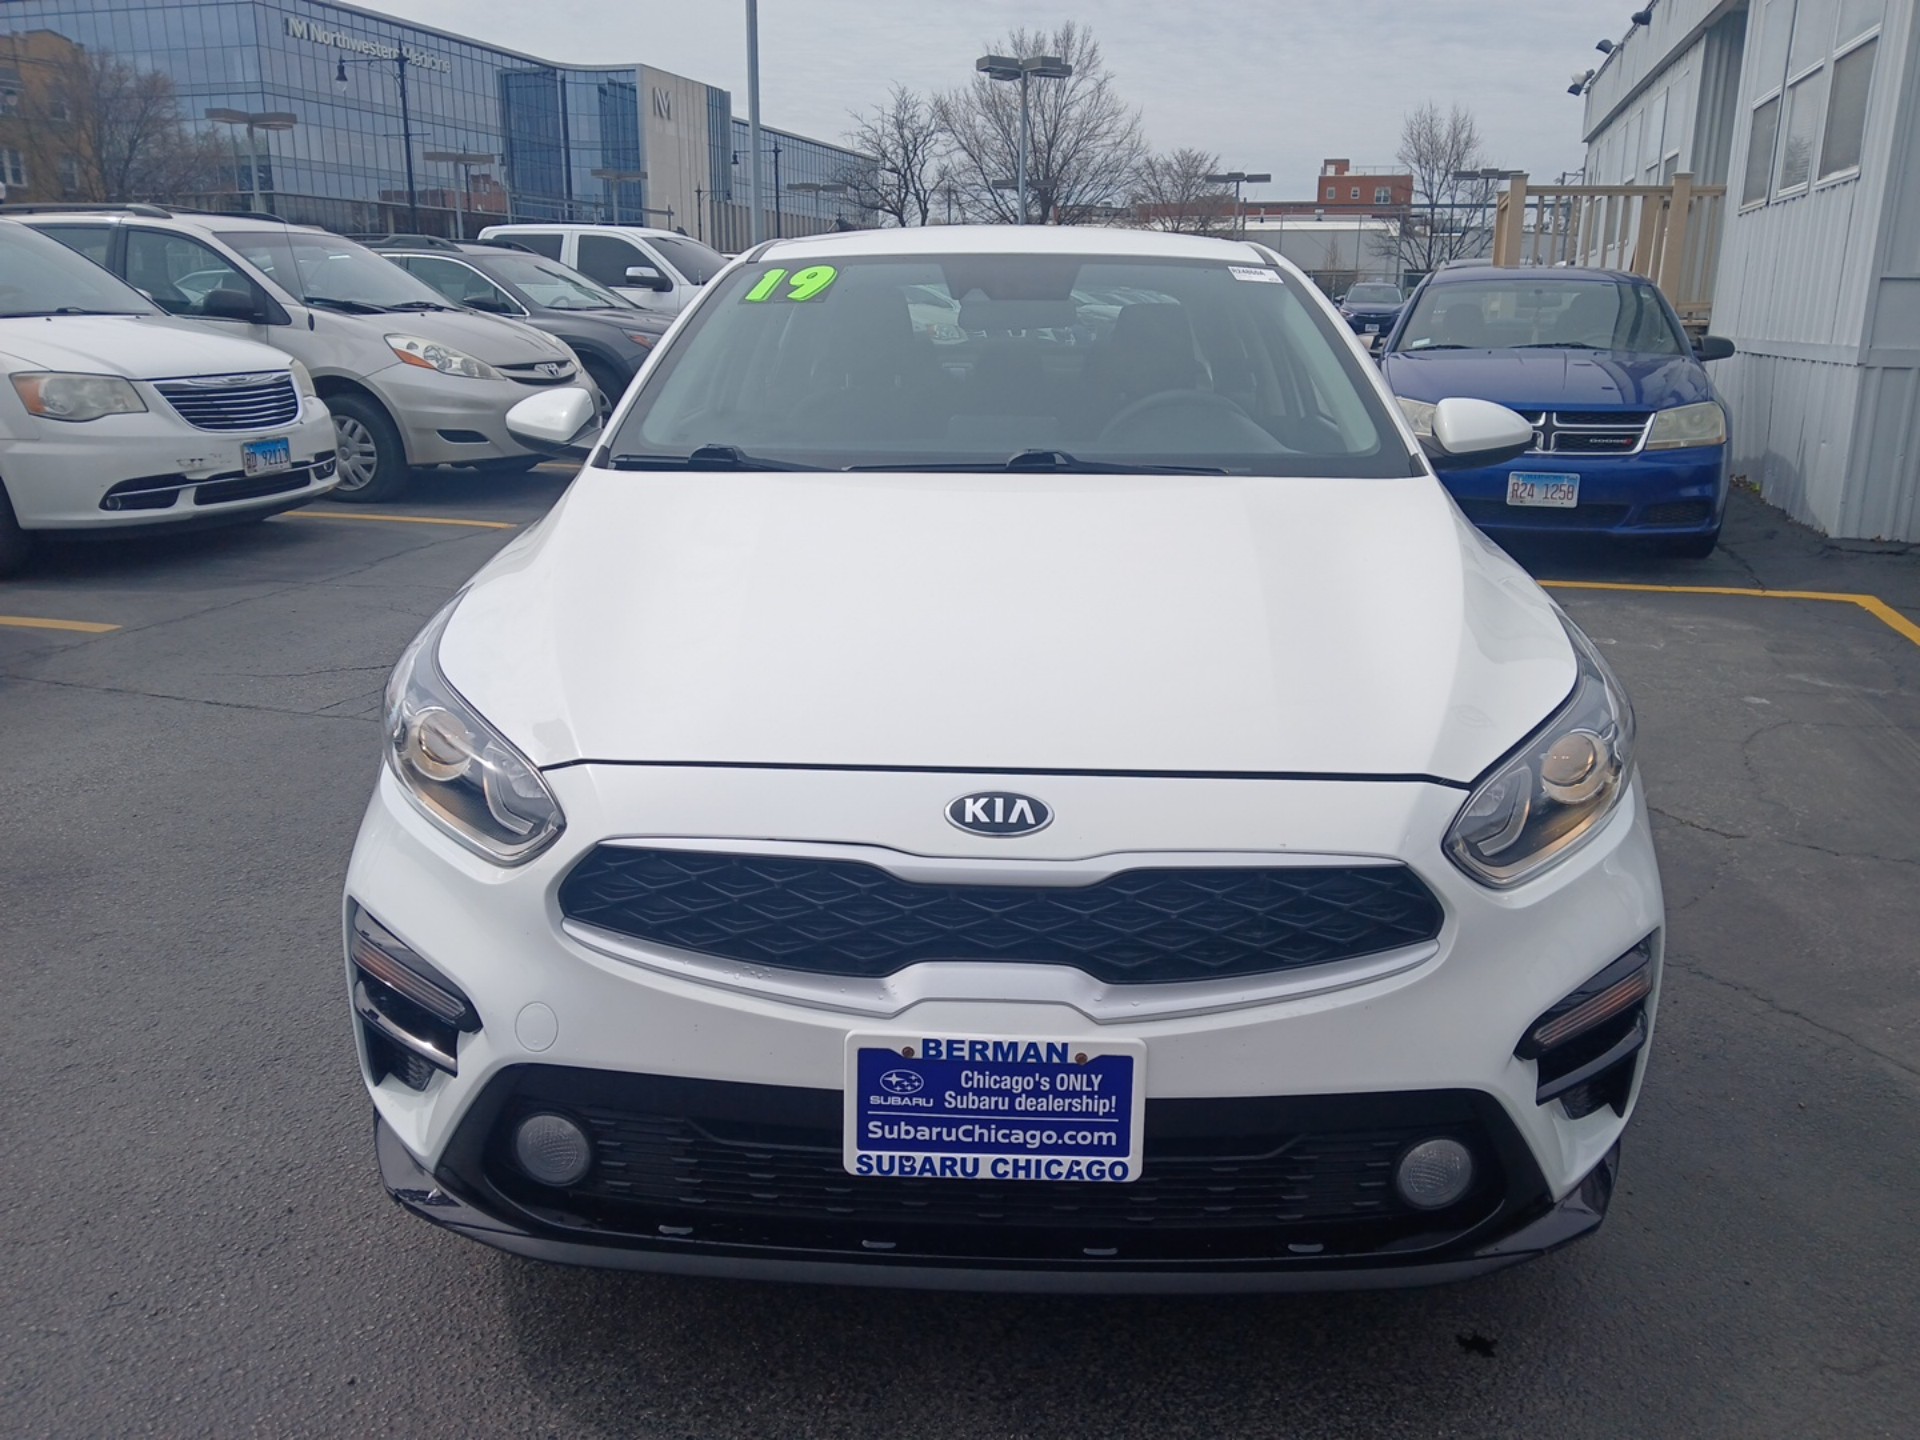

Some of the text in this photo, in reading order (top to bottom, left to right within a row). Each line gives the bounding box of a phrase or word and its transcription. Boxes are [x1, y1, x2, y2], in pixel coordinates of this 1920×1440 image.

[310, 22, 400, 59] Northwestern
[744, 264, 838, 302] 19
[1542, 483, 1575, 501] 1258
[963, 797, 1036, 825] KIA
[921, 1038, 1069, 1064] BERMAN
[960, 1070, 1102, 1092] Chicago's ONLY
[869, 1095, 933, 1107] SUBARU
[944, 1091, 1117, 1116] Subaru dealership!
[867, 1120, 1117, 1149] SubaruChicago.com
[856, 1154, 1129, 1181] SUBARU CHICAGO
